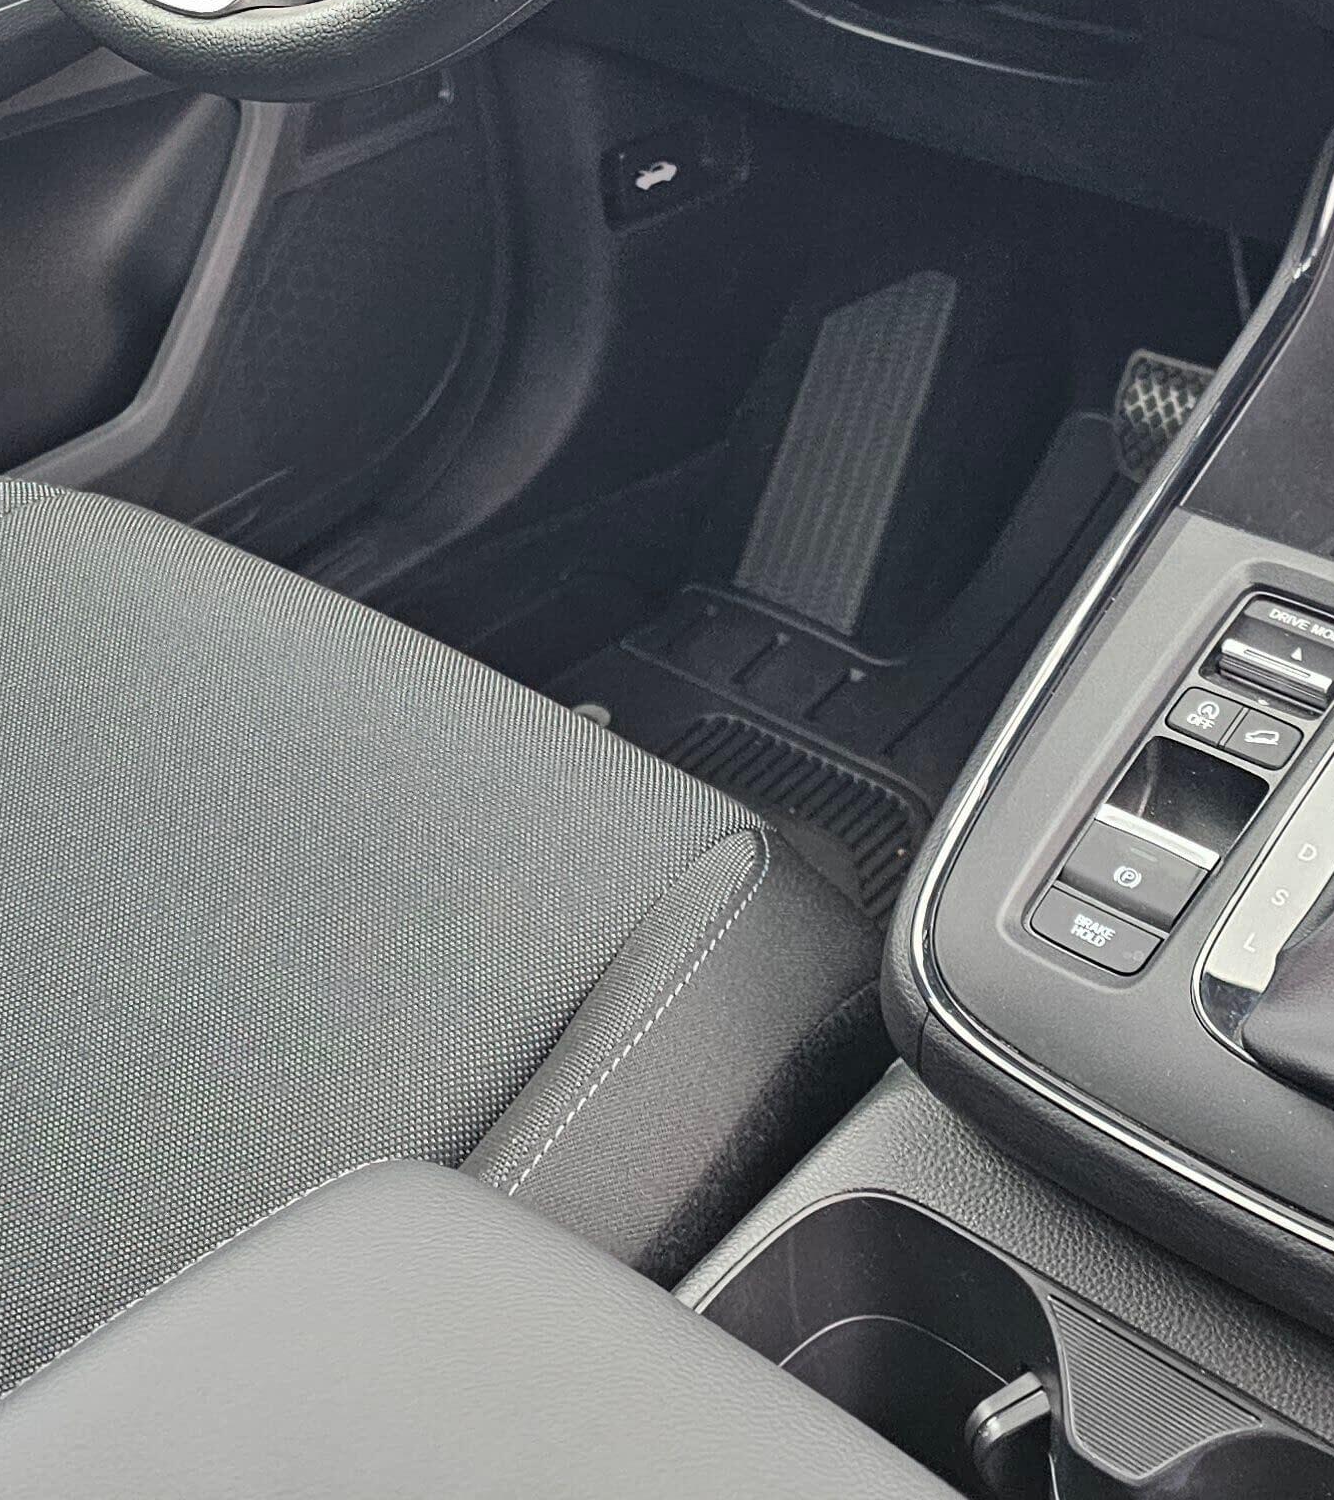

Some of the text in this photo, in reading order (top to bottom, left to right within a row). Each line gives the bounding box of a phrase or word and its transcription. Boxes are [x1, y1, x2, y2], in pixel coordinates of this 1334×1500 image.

[1269, 607, 1310, 631] DRIVE
[1298, 843, 1317, 862] D
[1271, 888, 1289, 906] S
[1070, 924, 1106, 947] HOLD
[1074, 913, 1116, 941] BRAKE
[1243, 933, 1256, 953] L
